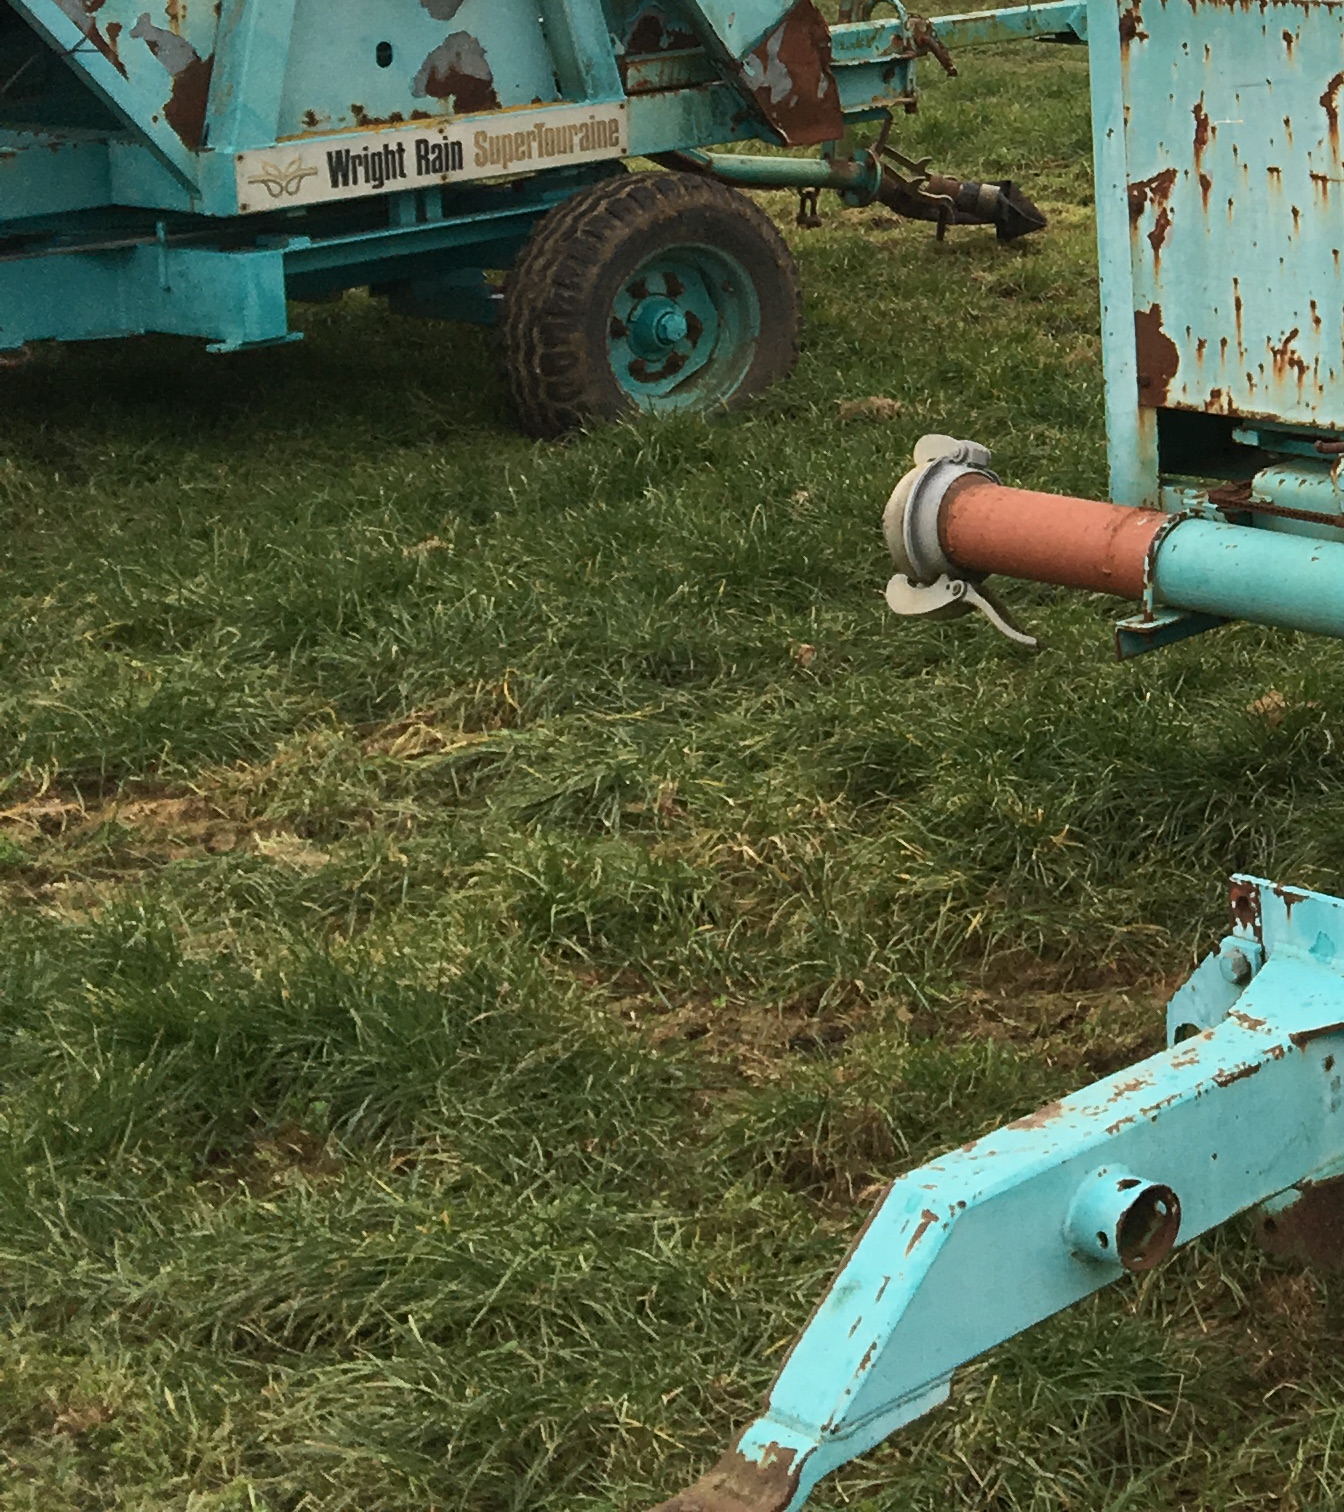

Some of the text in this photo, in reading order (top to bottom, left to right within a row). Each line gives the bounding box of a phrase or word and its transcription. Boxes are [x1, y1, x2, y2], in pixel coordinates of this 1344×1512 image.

[326, 115, 620, 189] Wright Rain SuperTouraine
